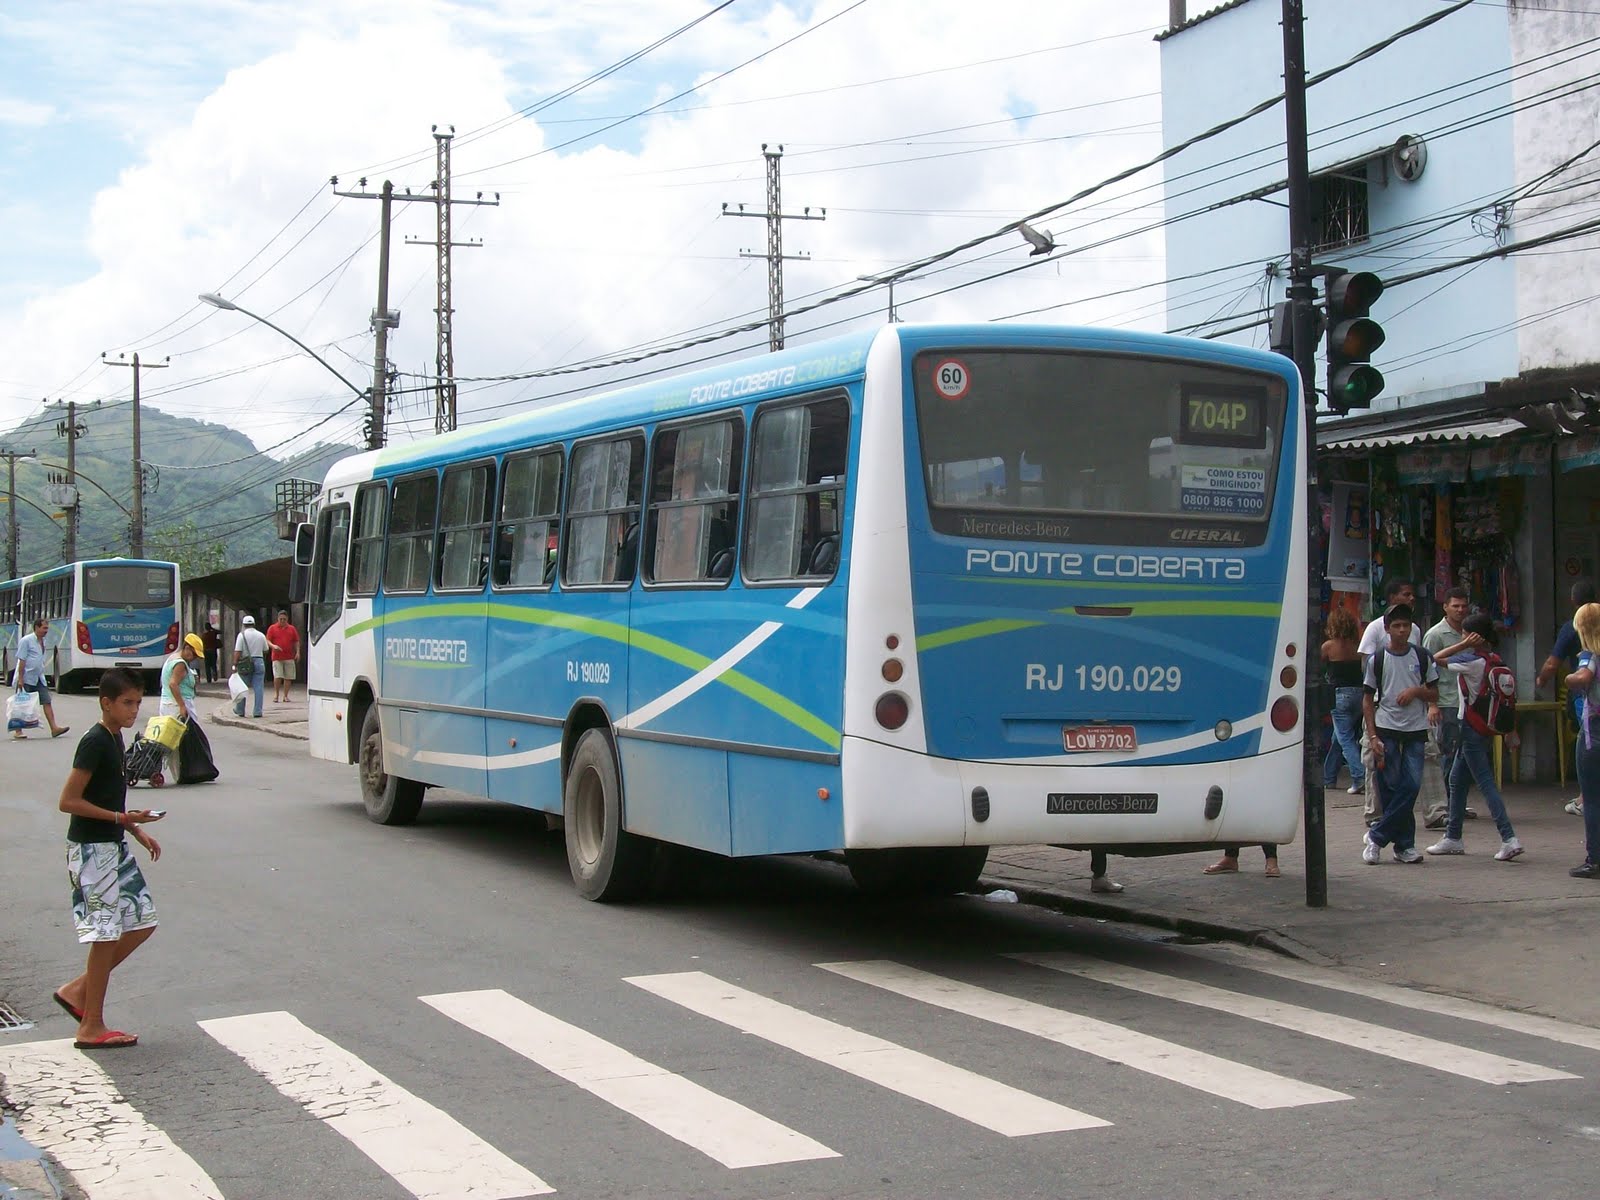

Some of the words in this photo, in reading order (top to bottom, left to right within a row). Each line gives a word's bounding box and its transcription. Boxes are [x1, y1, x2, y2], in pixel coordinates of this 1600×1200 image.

[941, 367, 962, 384] 60
[1189, 400, 1247, 430] 704P
[1207, 468, 1234, 479] COMO
[1236, 471, 1264, 481] ESTOU
[1210, 479, 1261, 490] DIRIGINDO?
[1183, 494, 1210, 505] 0800
[1213, 496, 1233, 507] 886
[1237, 498, 1263, 509] 1000
[961, 518, 1071, 539] Mercedes-Benz
[1170, 528, 1243, 543] CIFERAL
[110, 634, 121, 642] RJ
[566, 660, 579, 682] RJ
[1025, 663, 1064, 691] RJ
[1075, 664, 1182, 692] 190.029
[1049, 794, 1156, 812] Mercedes-Benz
